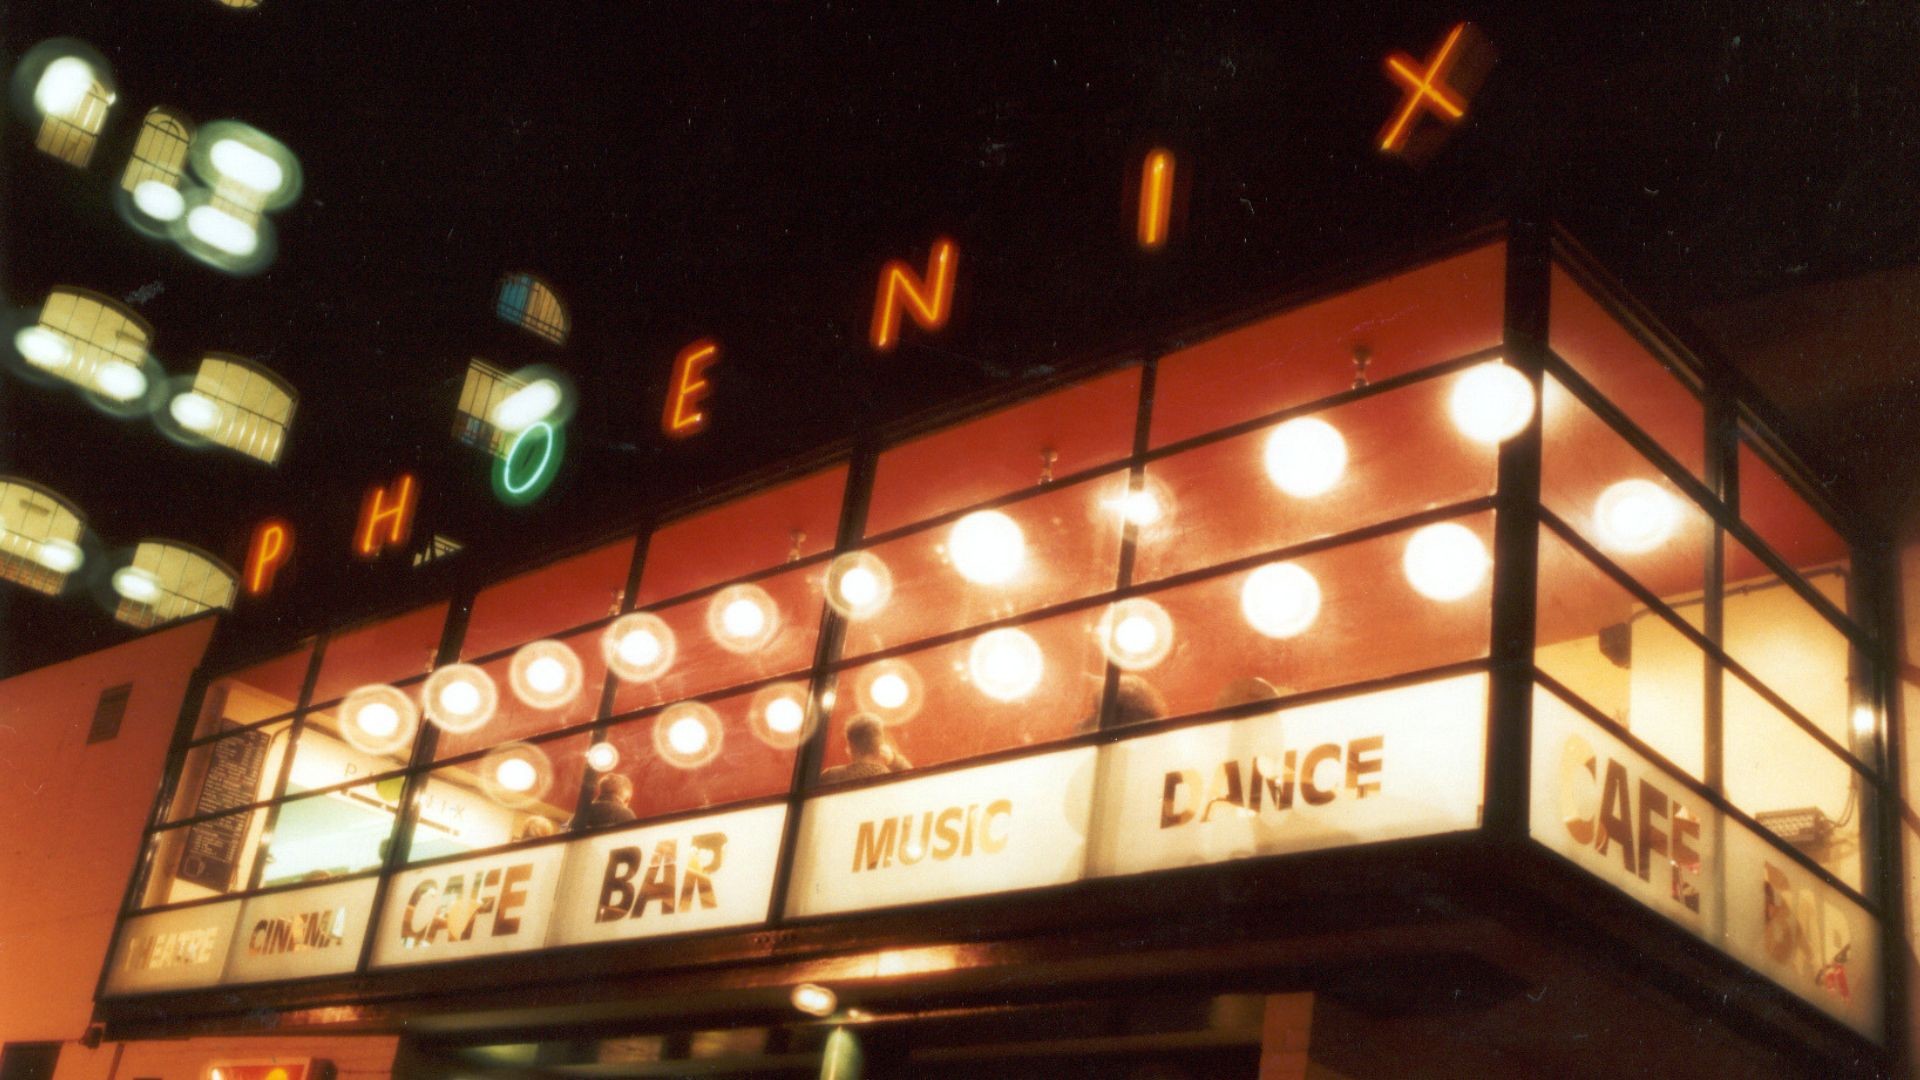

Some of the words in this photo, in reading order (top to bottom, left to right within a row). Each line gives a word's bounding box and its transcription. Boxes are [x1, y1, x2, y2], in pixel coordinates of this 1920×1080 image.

[250, 20, 1468, 594] PHOENIX
[1159, 734, 1385, 829] DANCE
[1560, 732, 1700, 914] CAFE
[851, 798, 1013, 873] MUSIC
[249, 905, 344, 955] CINEMA
[400, 862, 534, 949] CAFE
[594, 831, 728, 924] BAR
